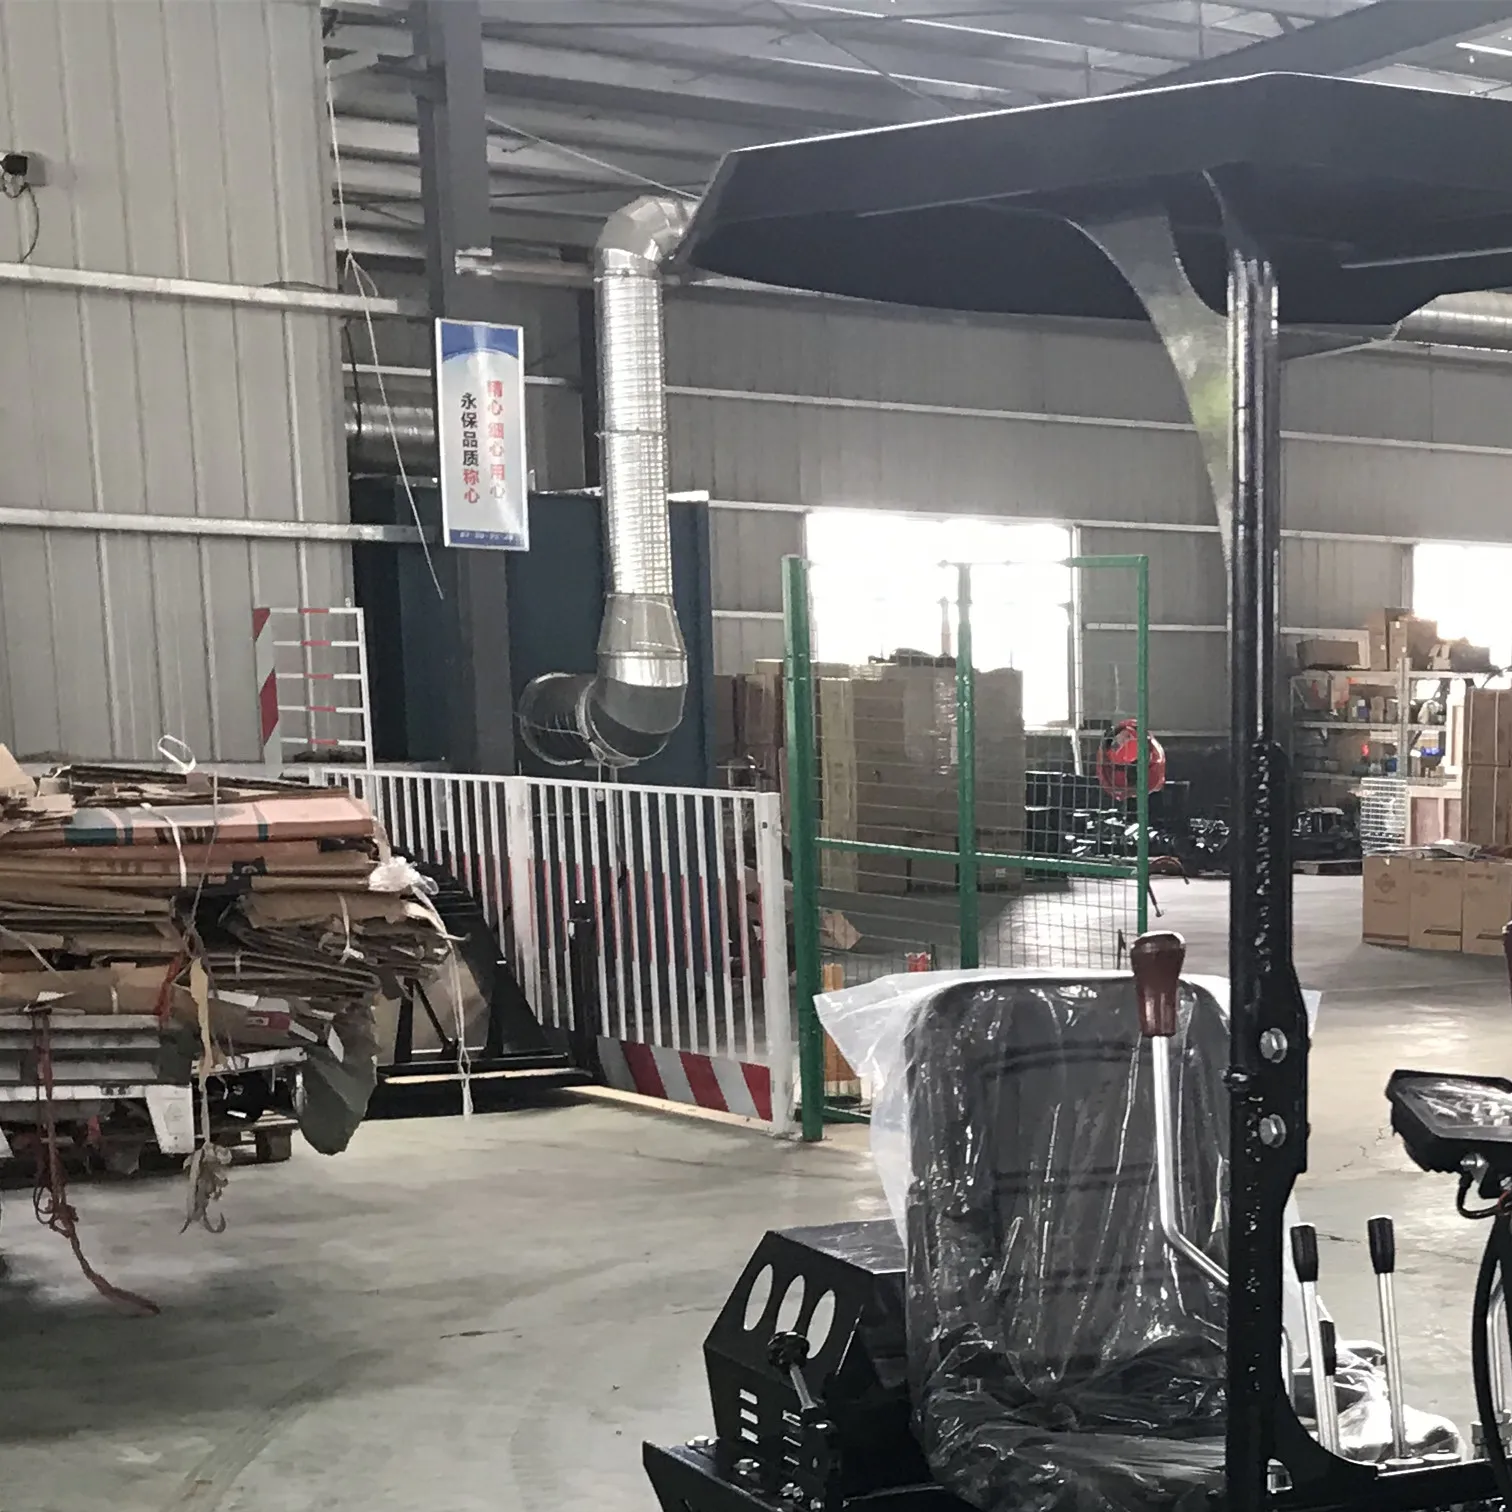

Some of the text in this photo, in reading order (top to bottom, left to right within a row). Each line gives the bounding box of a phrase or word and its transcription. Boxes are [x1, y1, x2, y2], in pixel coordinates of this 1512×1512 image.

[460, 393, 480, 504] 永保品质称心
